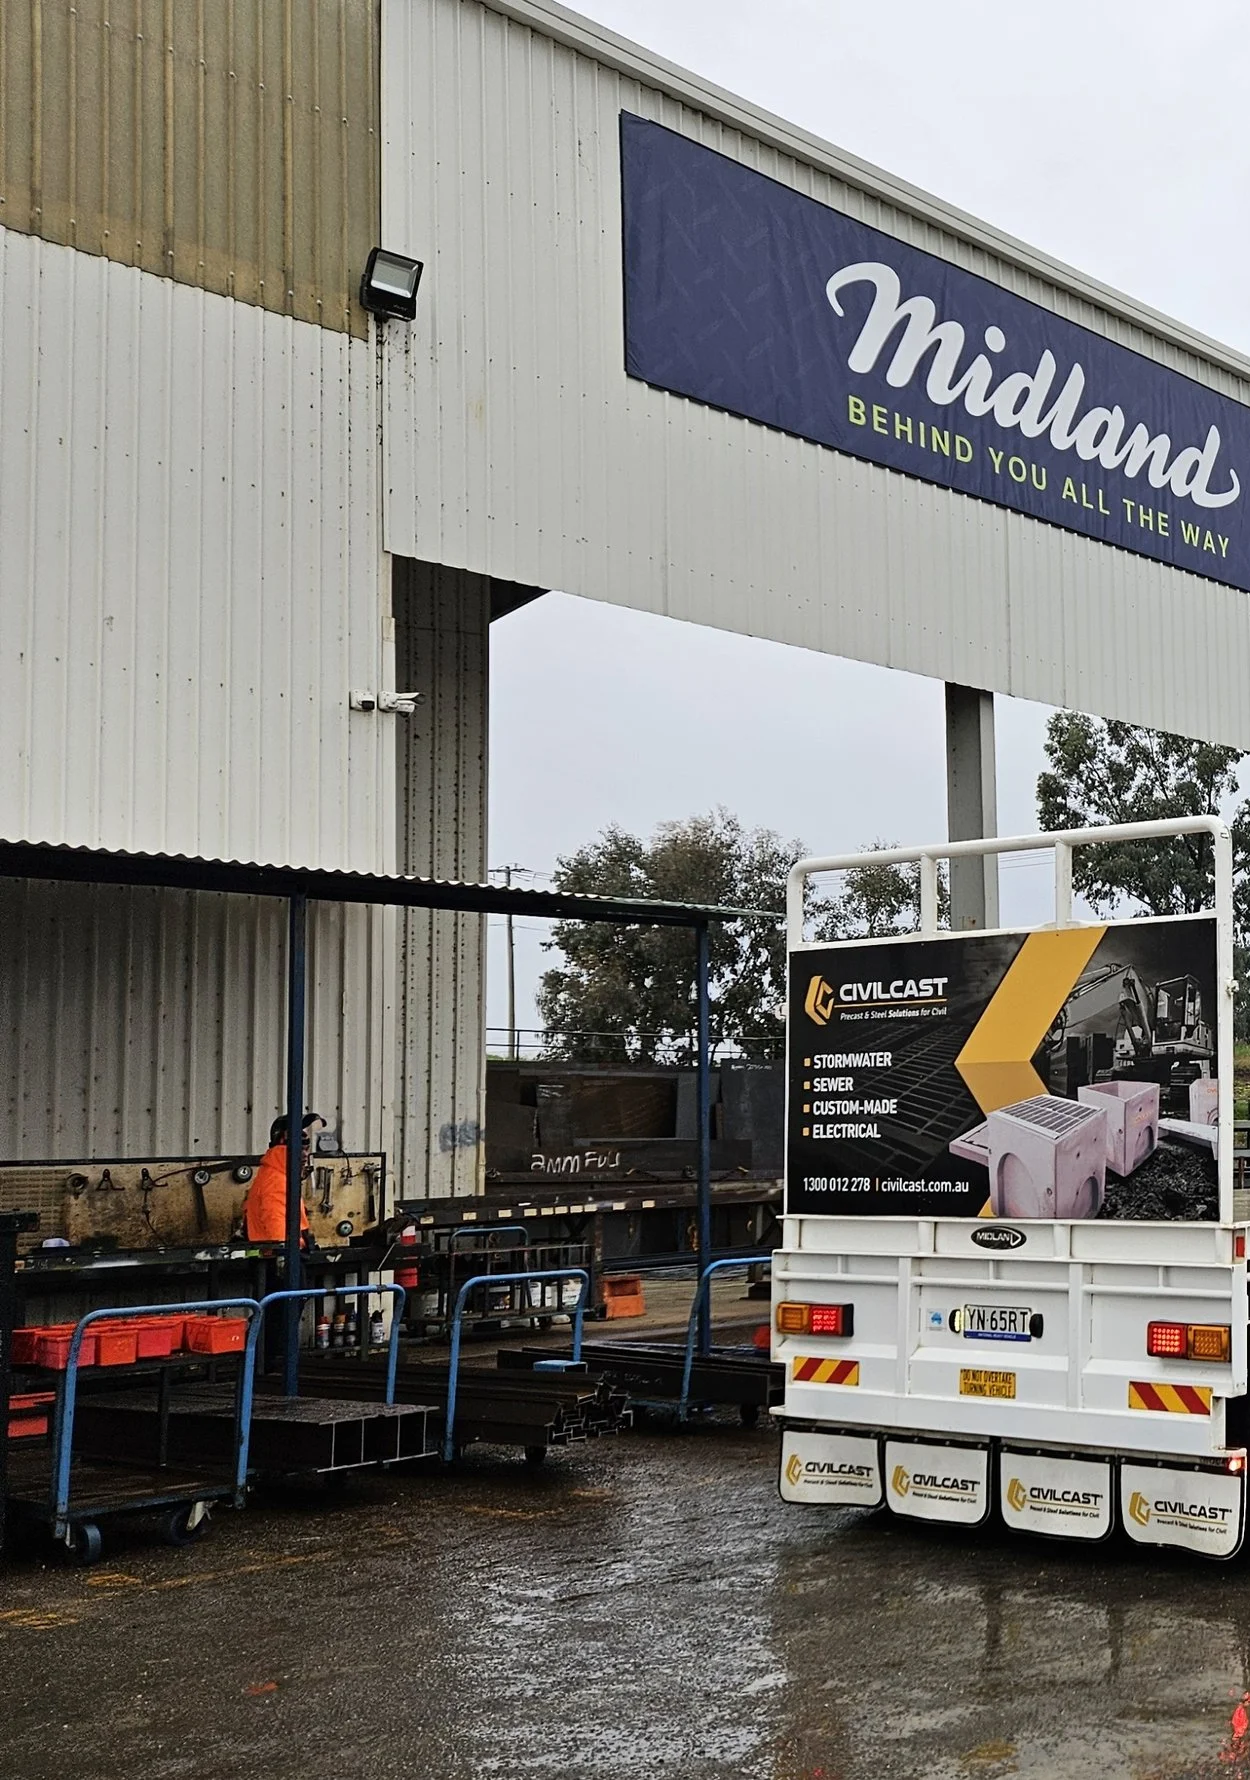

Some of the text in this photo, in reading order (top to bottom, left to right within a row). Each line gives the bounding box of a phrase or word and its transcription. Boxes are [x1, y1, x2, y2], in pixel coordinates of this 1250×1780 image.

[826, 261, 1241, 508] Midland
[848, 395, 1230, 558] BEHIND YOU ALL THE WAY
[839, 977, 949, 1001] CIVILCAST
[840, 1012, 864, 1021] Precast
[870, 1010, 888, 1020] Steel
[888, 1008, 920, 1018] Solutions
[920, 1008, 931, 1017] for
[931, 1006, 947, 1016] Civil
[813, 1051, 893, 1069] STORMWATER
[813, 1077, 854, 1092] SEWER
[812, 1099, 898, 1116] CUSTOM-MADE
[812, 1123, 882, 1139] ELECTRICAL
[803, 1177, 969, 1193] 1300 012 278 civilcast.com.au
[972, 1371, 983, 1382] NOT
[804, 1461, 873, 1477] CIVILCAST
[912, 1473, 978, 1492] CIVILCAST
[1029, 1487, 1101, 1506] CIVILCAST
[1154, 1500, 1231, 1521] CIVILCAST
